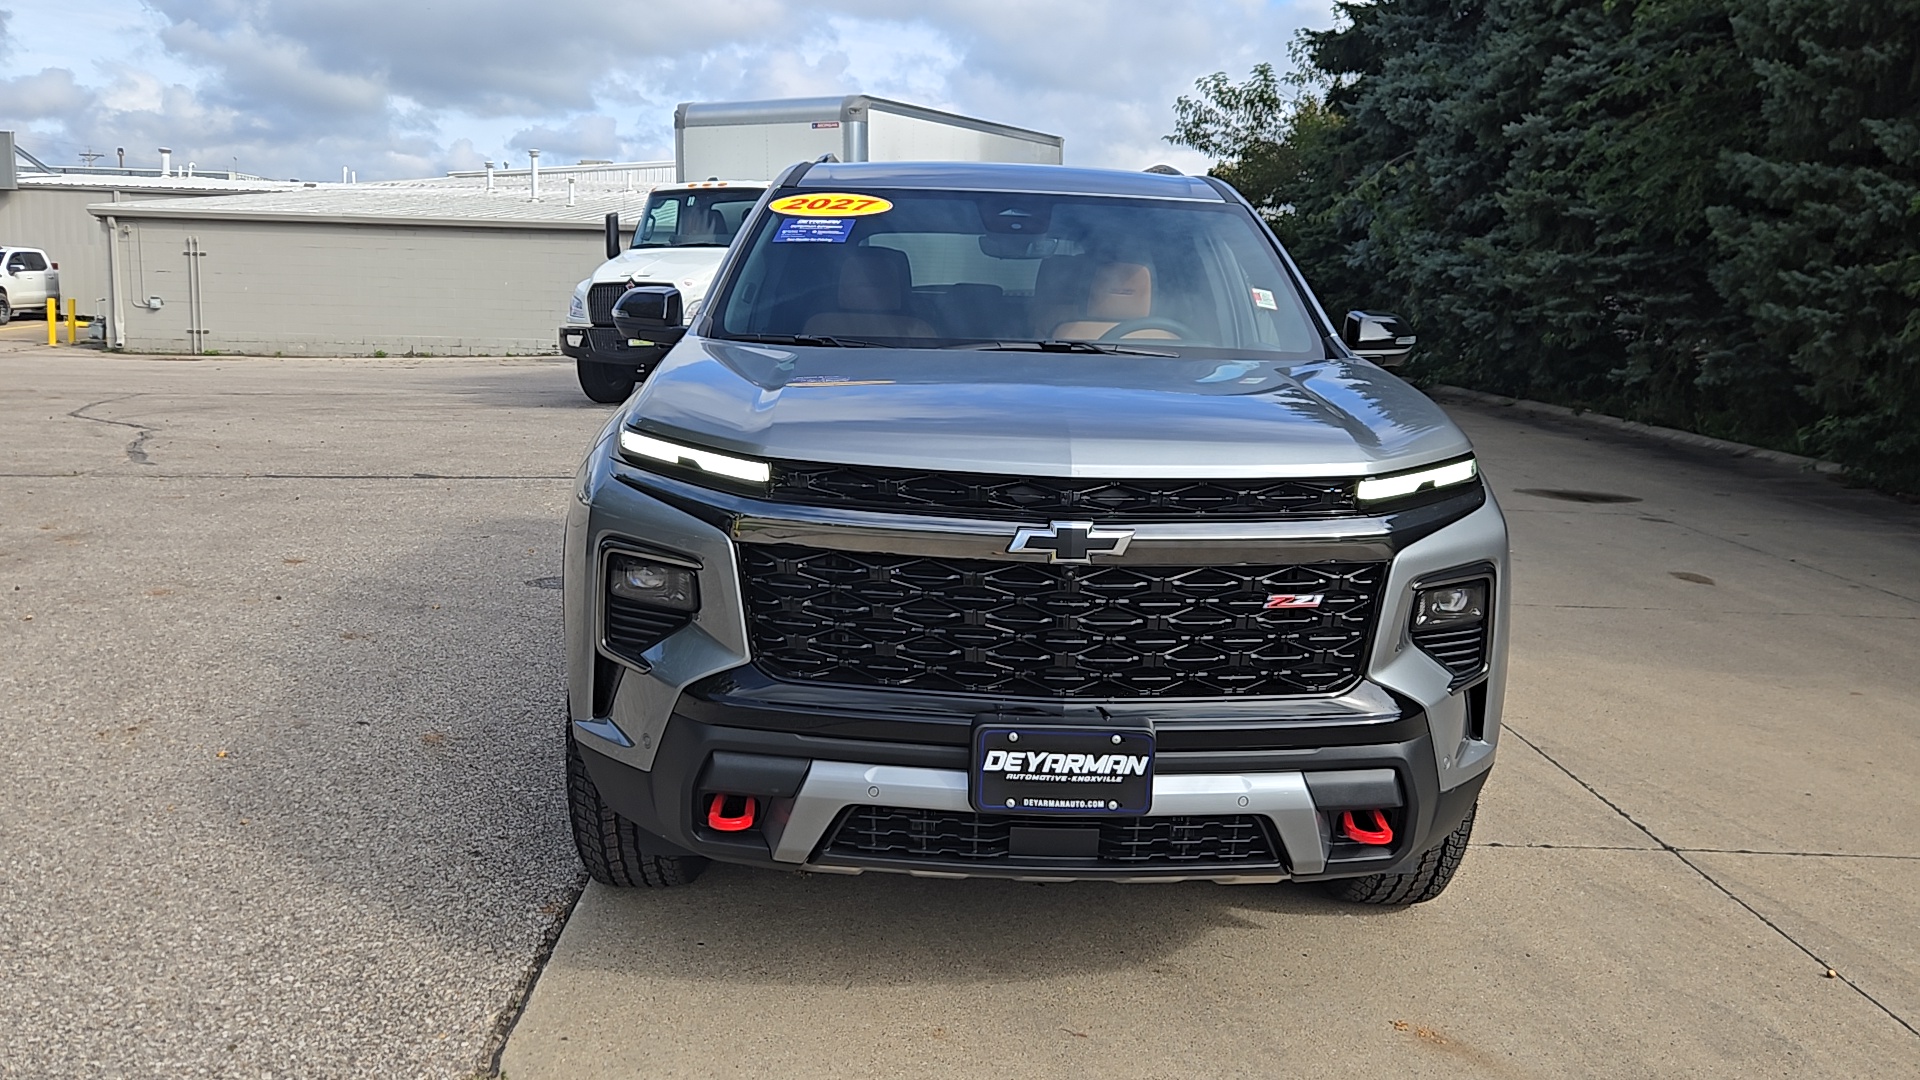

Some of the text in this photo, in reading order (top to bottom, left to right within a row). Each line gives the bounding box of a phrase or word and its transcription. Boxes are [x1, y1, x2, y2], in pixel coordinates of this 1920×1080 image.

[781, 199, 881, 211] 2027
[983, 750, 1149, 775] DEYARMAN
[1023, 798, 1105, 808] DEYARMANAUTO.COM
